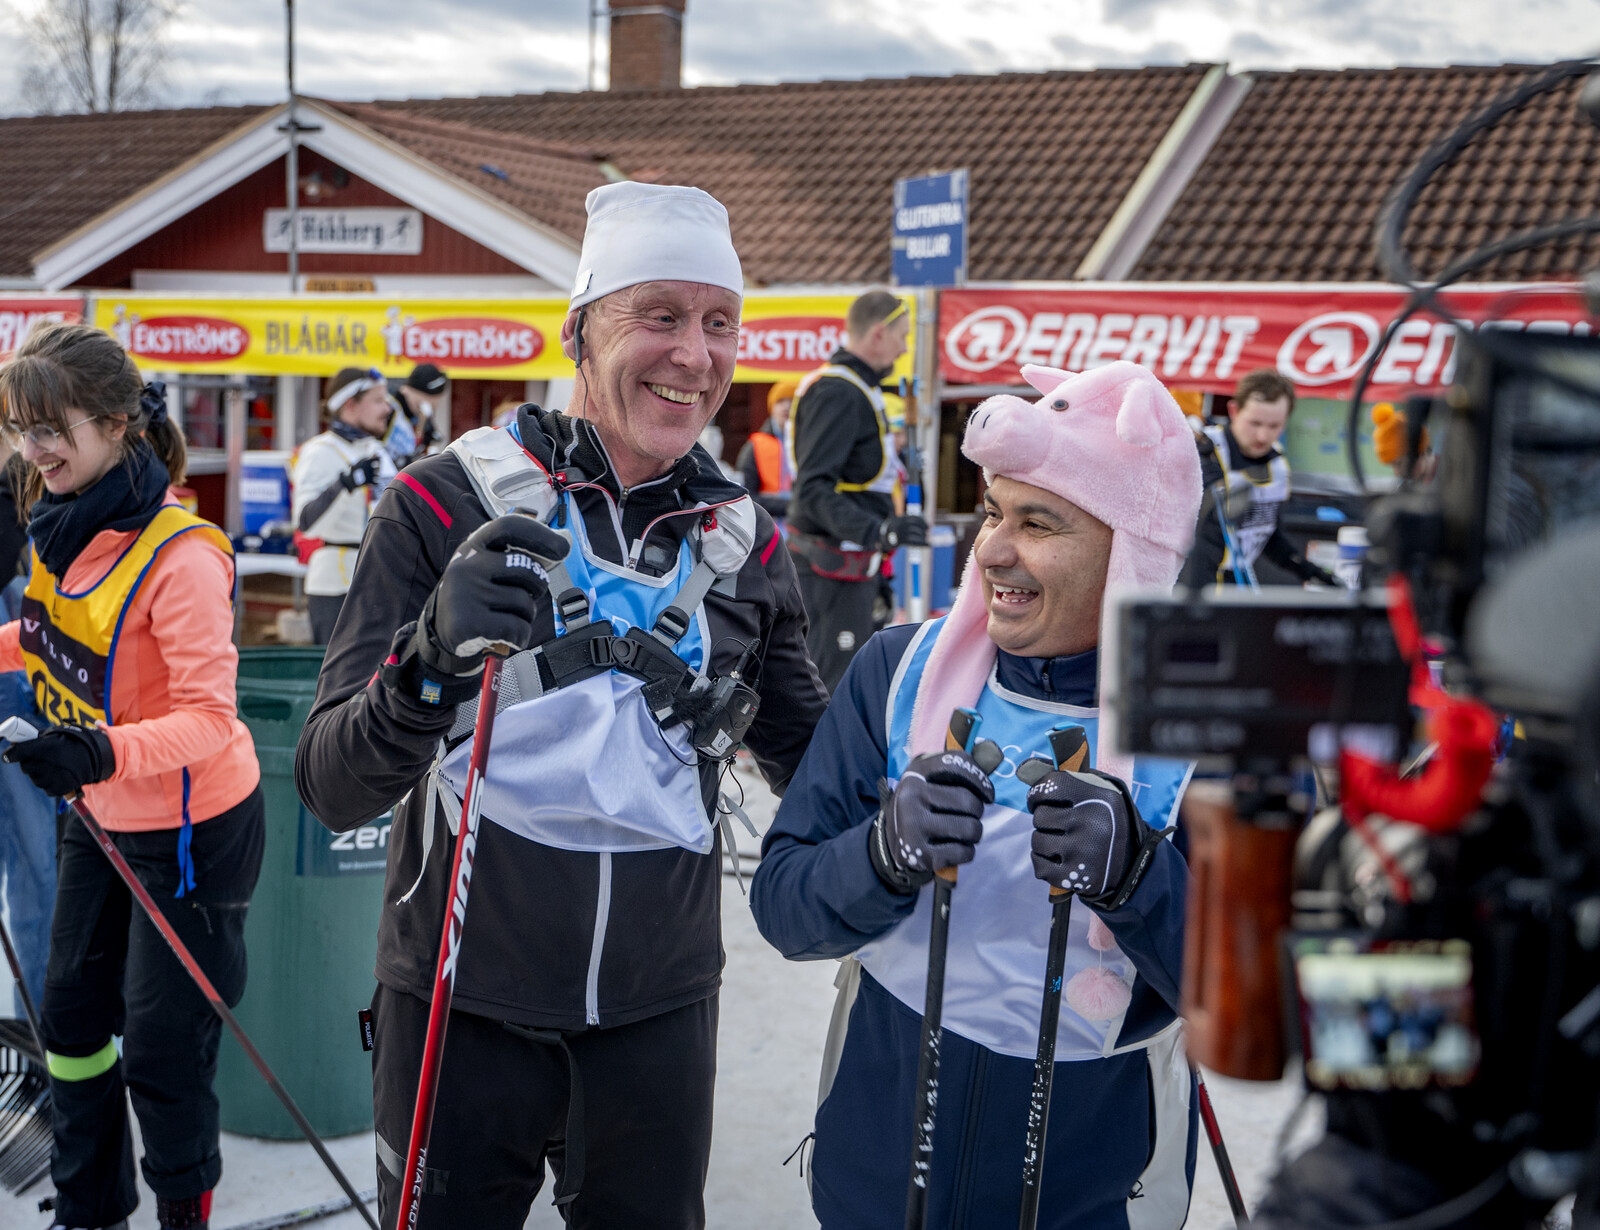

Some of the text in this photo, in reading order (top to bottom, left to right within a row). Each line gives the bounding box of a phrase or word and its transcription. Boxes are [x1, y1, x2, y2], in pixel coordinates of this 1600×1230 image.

[133, 323, 241, 355] EKSTRÖMS
[405, 326, 533, 359] EKSTRÖMS
[737, 326, 849, 361] EKSTRÖ
[1016, 312, 1261, 379] ENERVIT
[23, 616, 89, 684] VOLVO
[941, 754, 986, 785] CRAFT
[413, 1147, 427, 1197] TRIAC
